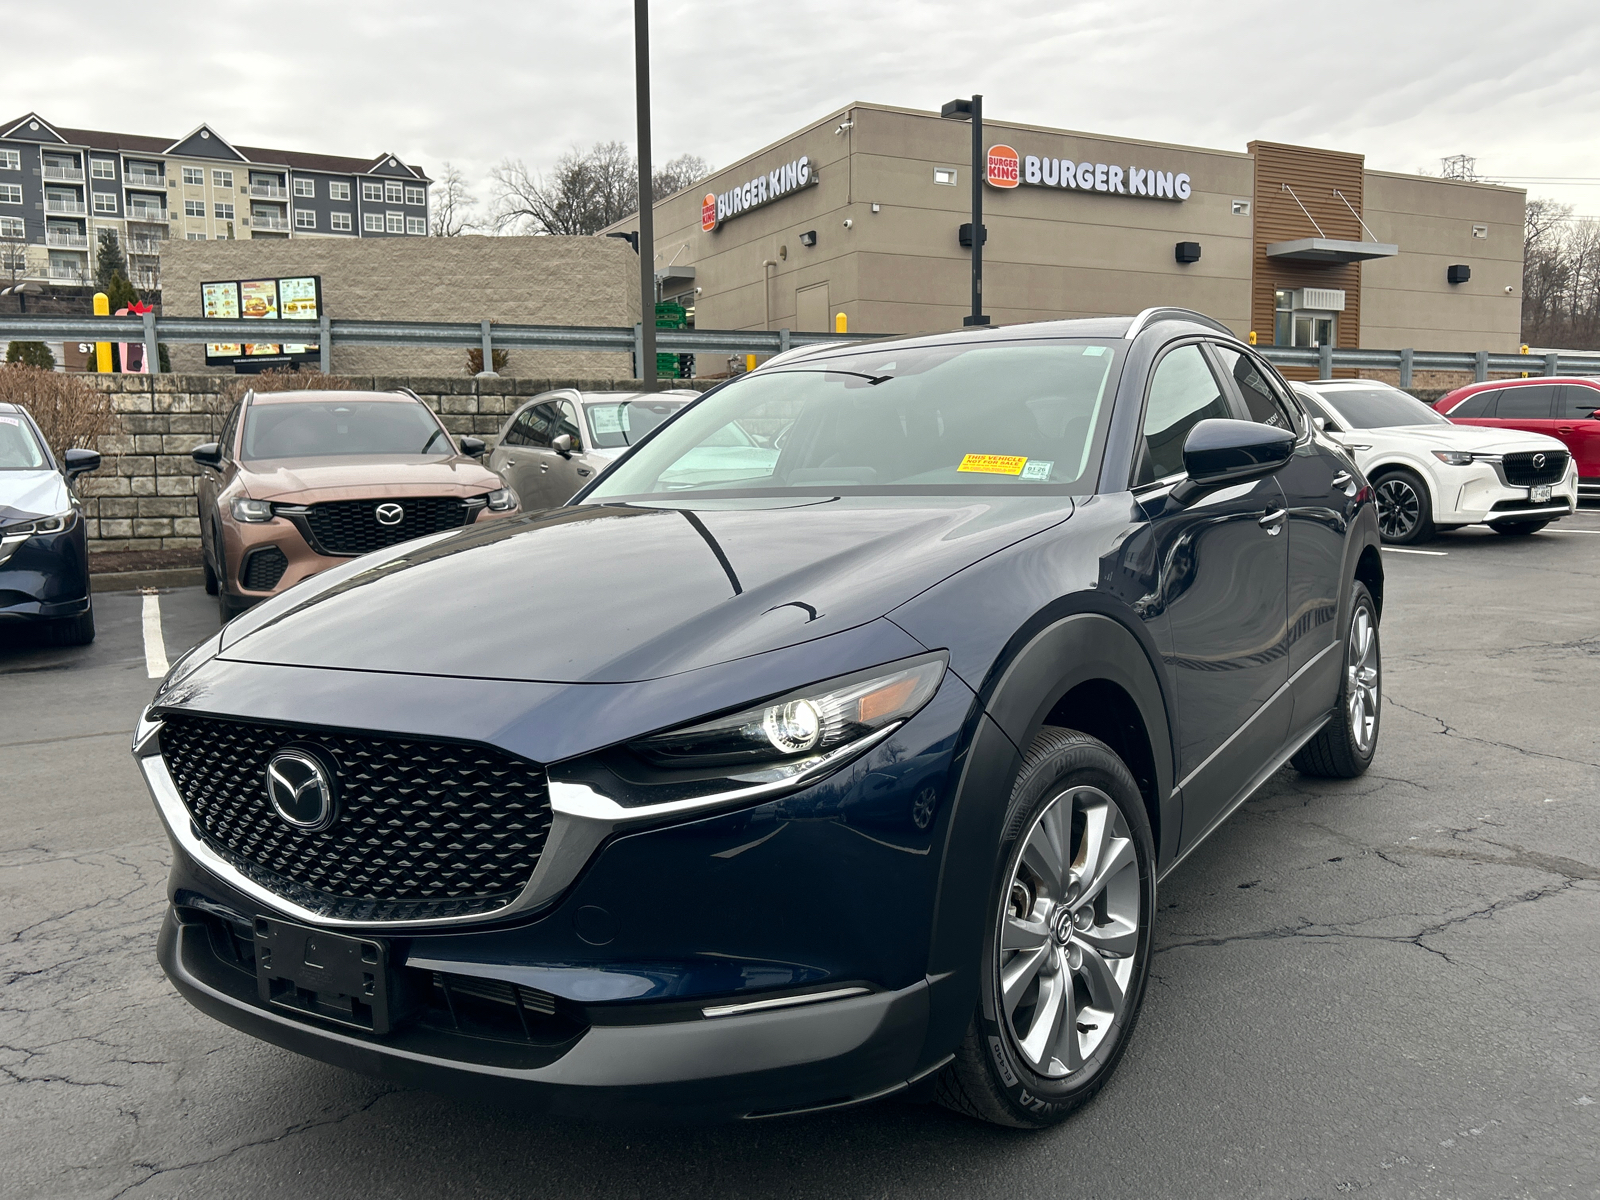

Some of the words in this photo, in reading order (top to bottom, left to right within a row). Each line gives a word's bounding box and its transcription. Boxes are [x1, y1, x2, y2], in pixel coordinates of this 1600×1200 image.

[989, 157, 1018, 168] BURGER
[989, 166, 1018, 180] KING
[1025, 155, 1124, 193] BURGER
[1129, 168, 1192, 200] KING
[717, 175, 768, 220] BURGER
[769, 156, 809, 199] KING
[702, 203, 715, 215] BURGER
[702, 210, 715, 226] KING
